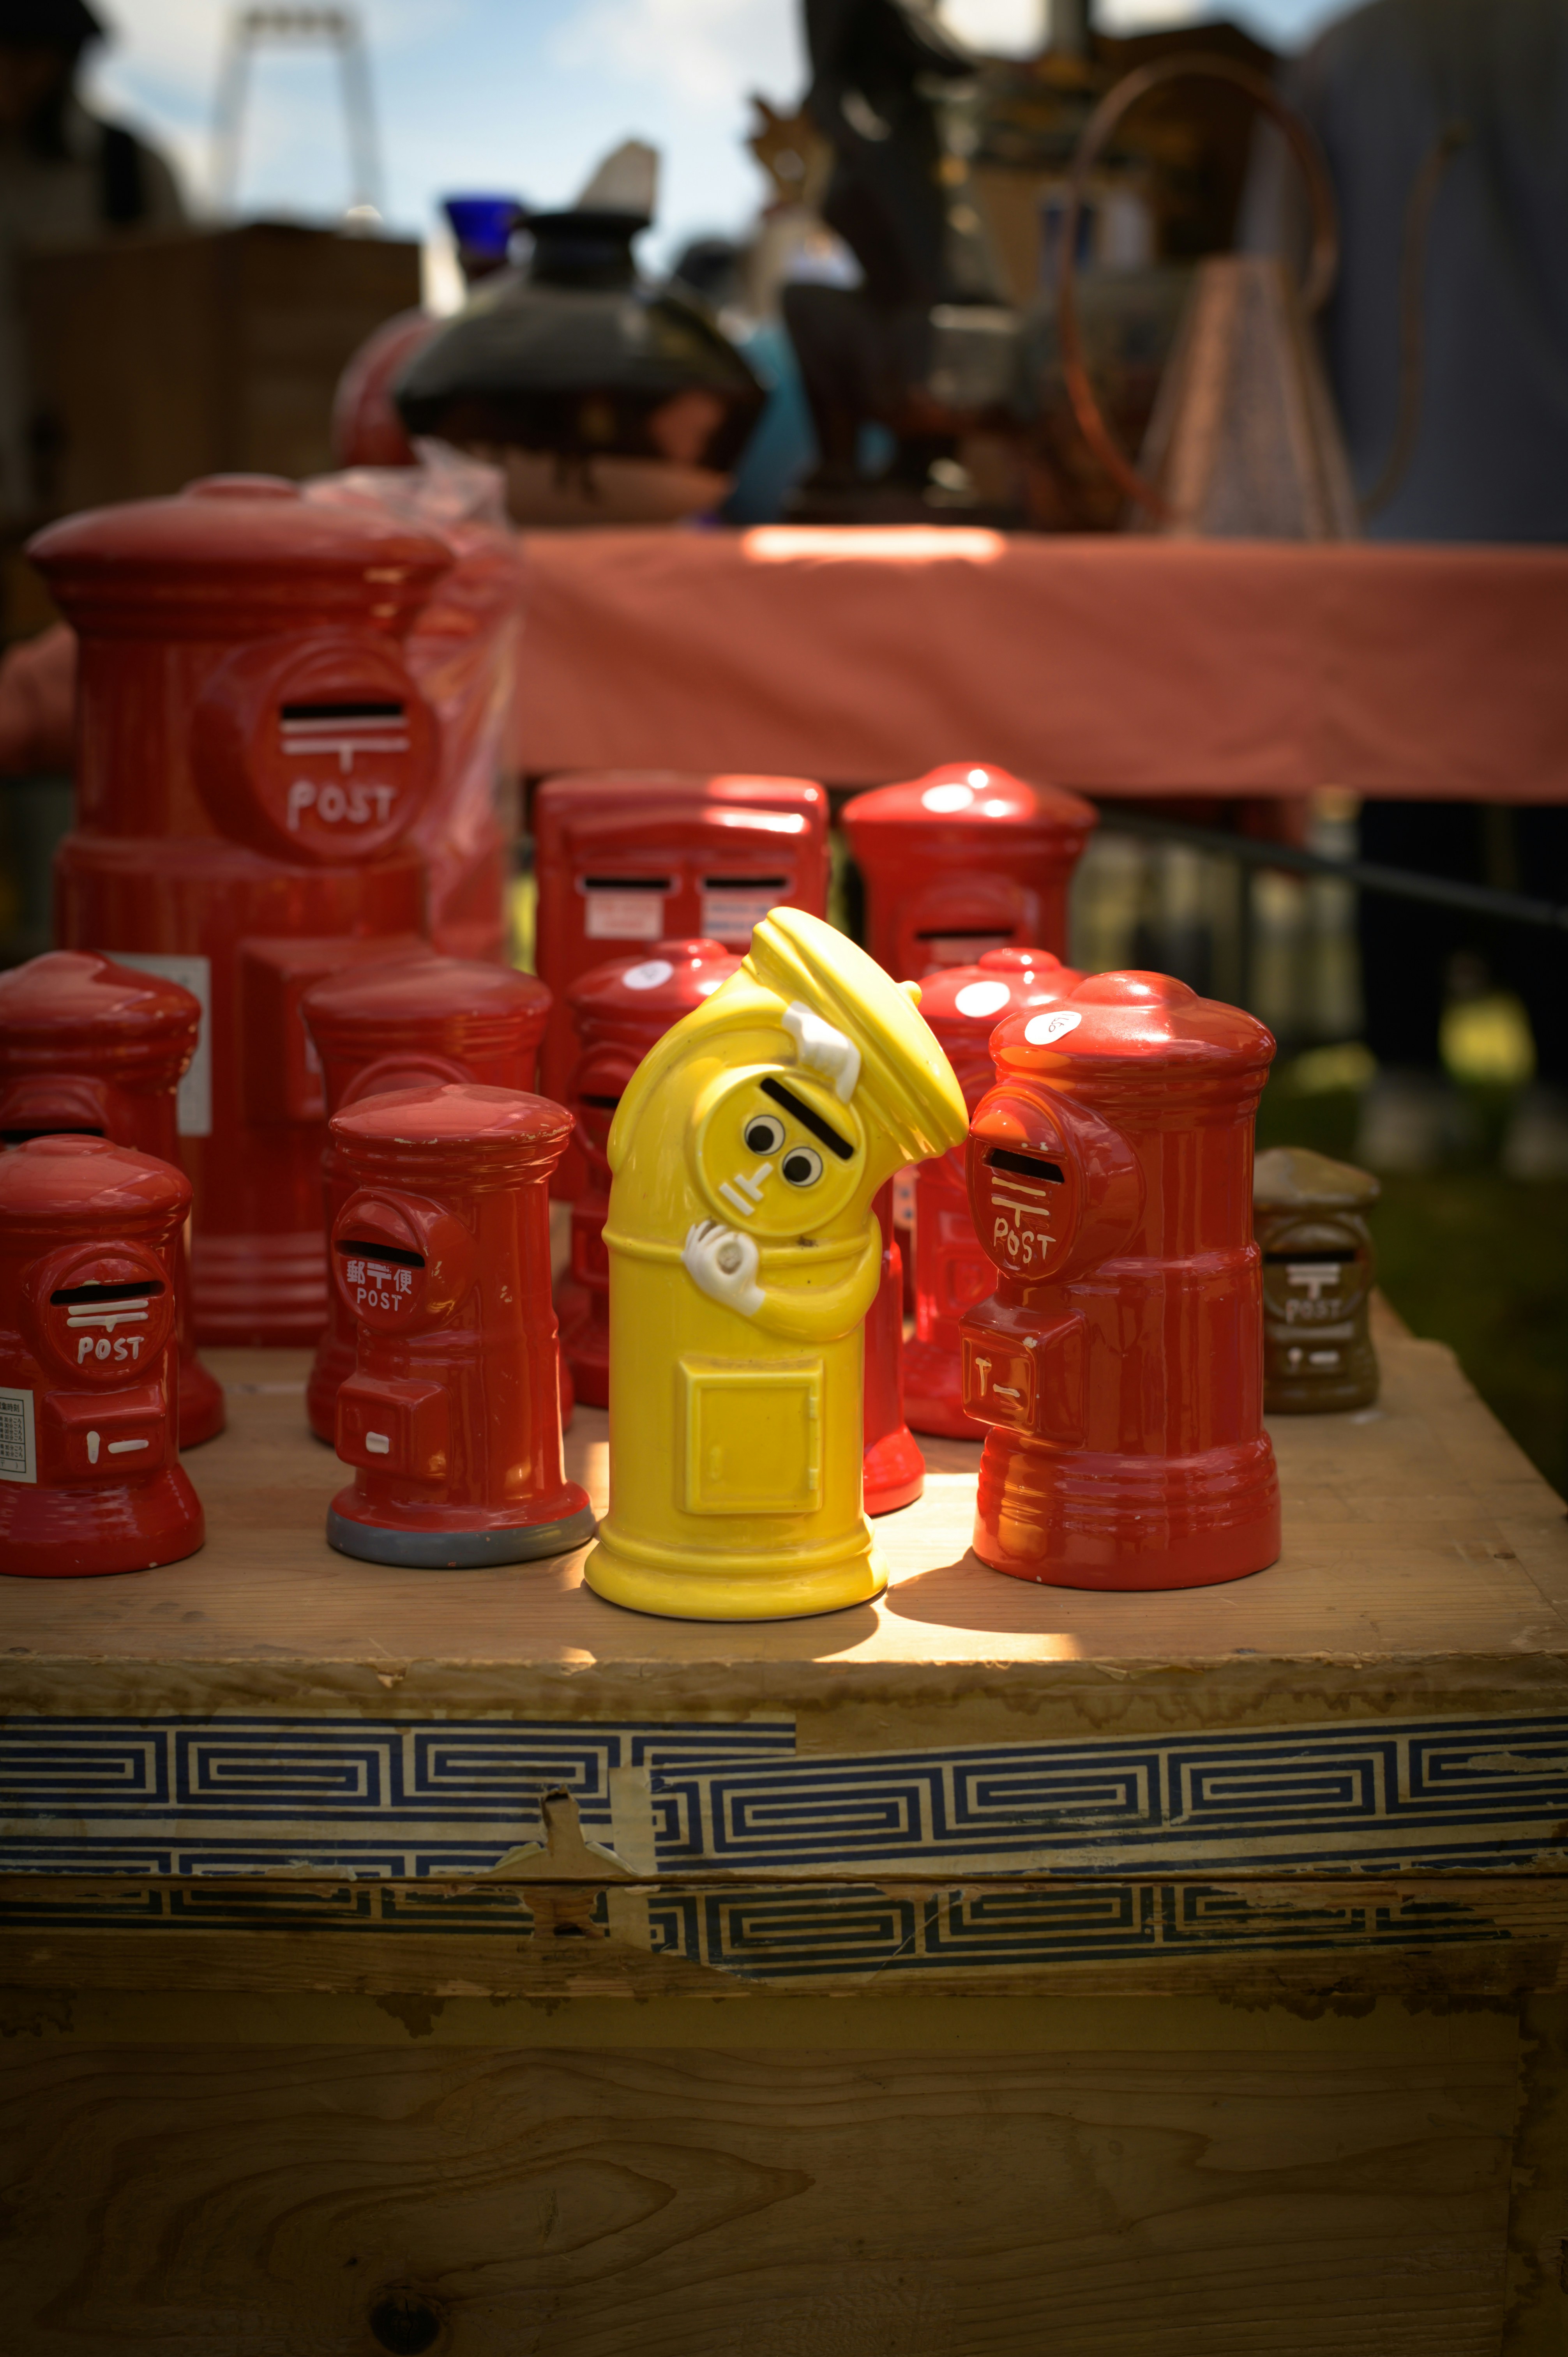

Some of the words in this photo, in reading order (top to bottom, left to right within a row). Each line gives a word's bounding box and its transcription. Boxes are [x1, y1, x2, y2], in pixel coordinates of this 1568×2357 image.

[288, 780, 397, 831] POST
[994, 1217, 1056, 1263] POST
[357, 1287, 402, 1311] POST
[78, 1337, 144, 1364] POST
